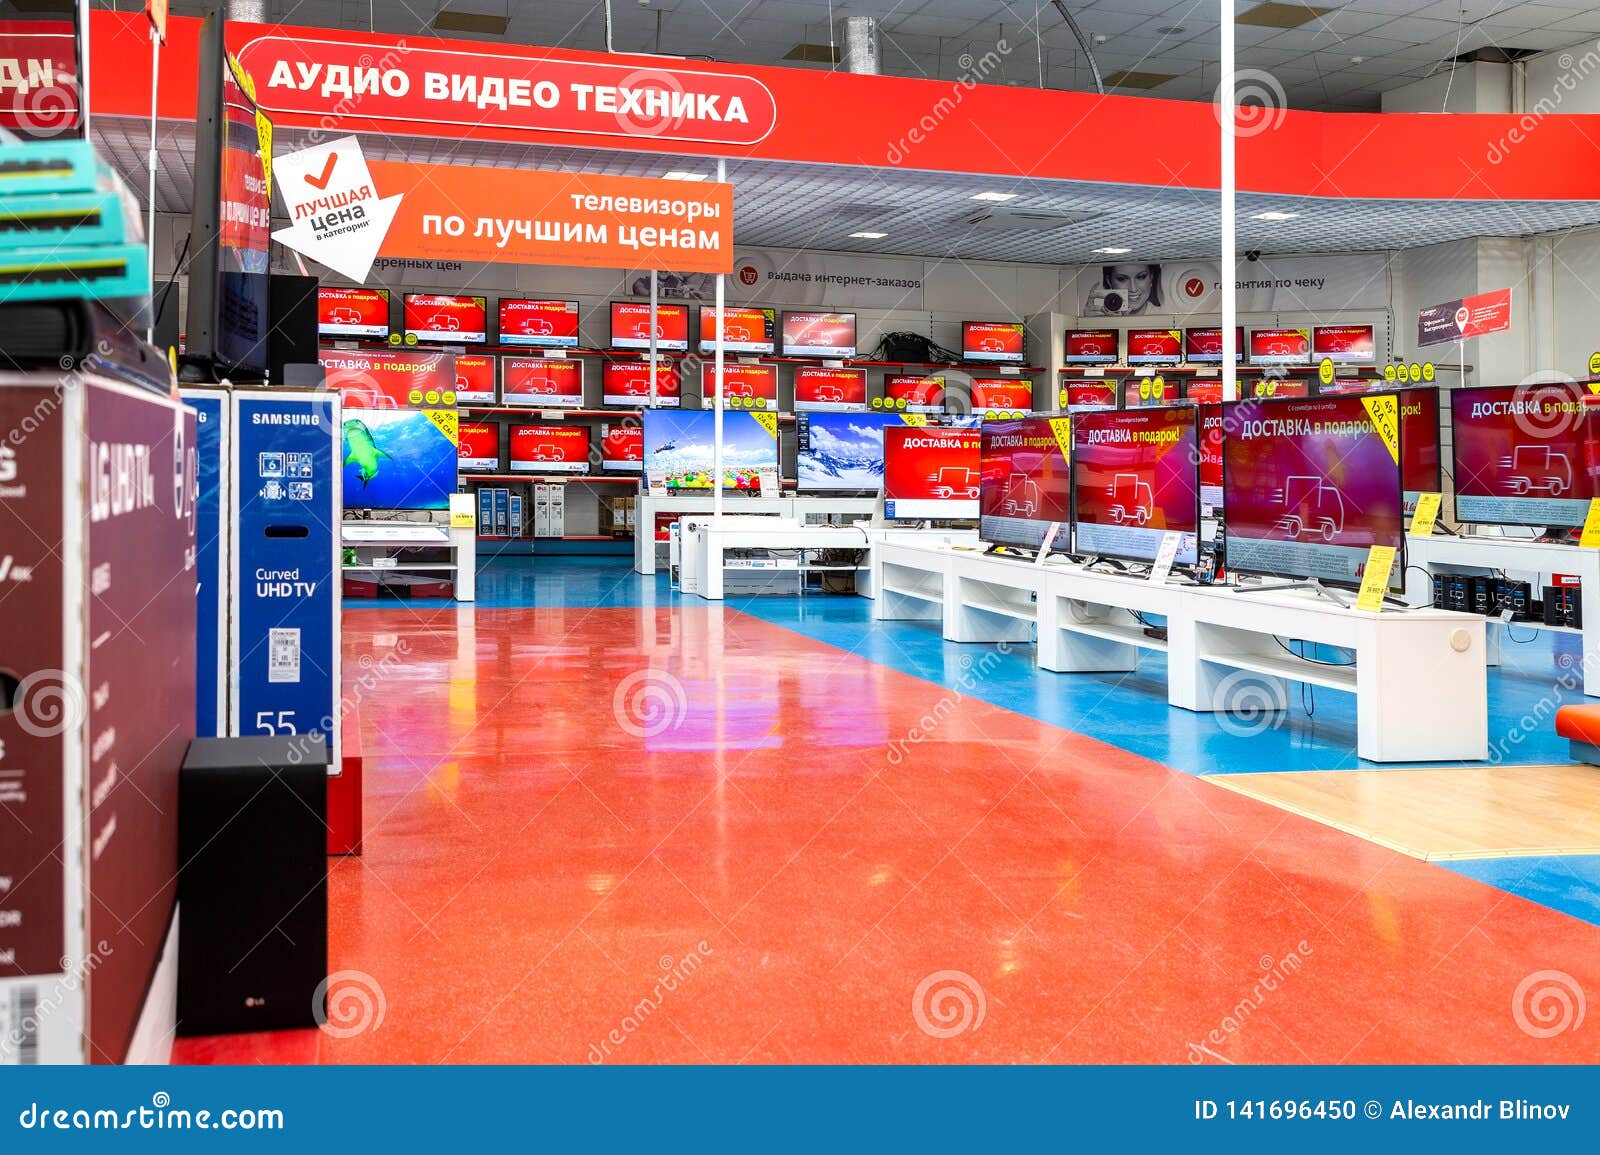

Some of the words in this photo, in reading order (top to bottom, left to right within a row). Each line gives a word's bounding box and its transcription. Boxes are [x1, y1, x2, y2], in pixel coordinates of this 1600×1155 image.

[268, 60, 410, 99] АУДИО
[425, 71, 560, 110] ВИДЕО
[571, 83, 749, 123] ТЕХНИКА
[295, 185, 372, 220] ЛУЧШАЯ
[571, 192, 721, 219] телевизоры
[311, 202, 366, 231] цена
[316, 232, 322, 241] в
[423, 215, 466, 236] по
[475, 219, 609, 248] лучшим
[618, 222, 721, 251] ценам
[374, 258, 433, 270] еренных
[437, 261, 462, 272] цен
[768, 271, 811, 283] выдача
[815, 274, 921, 288] интернет-заказов
[1214, 280, 1271, 290] гантия
[1275, 278, 1291, 288] по
[1295, 277, 1325, 290] чеку
[384, 362, 436, 373] подарок!
[1472, 401, 1541, 418] ДОСТАВКА
[1545, 404, 1551, 412] в
[252, 413, 320, 425] SAMSUNG
[1088, 430, 1132, 445] ДОСТАВКА
[1133, 432, 1138, 442] в
[1139, 429, 1180, 445] подарок!
[1242, 419, 1312, 440] ДОСТАВКА
[1314, 423, 1320, 435] в
[1324, 420, 1376, 440] подарок
[903, 438, 961, 449] ДОСТАВКА
[991, 436, 1023, 449] ДОСТАВКА
[256, 568, 299, 580] Curved
